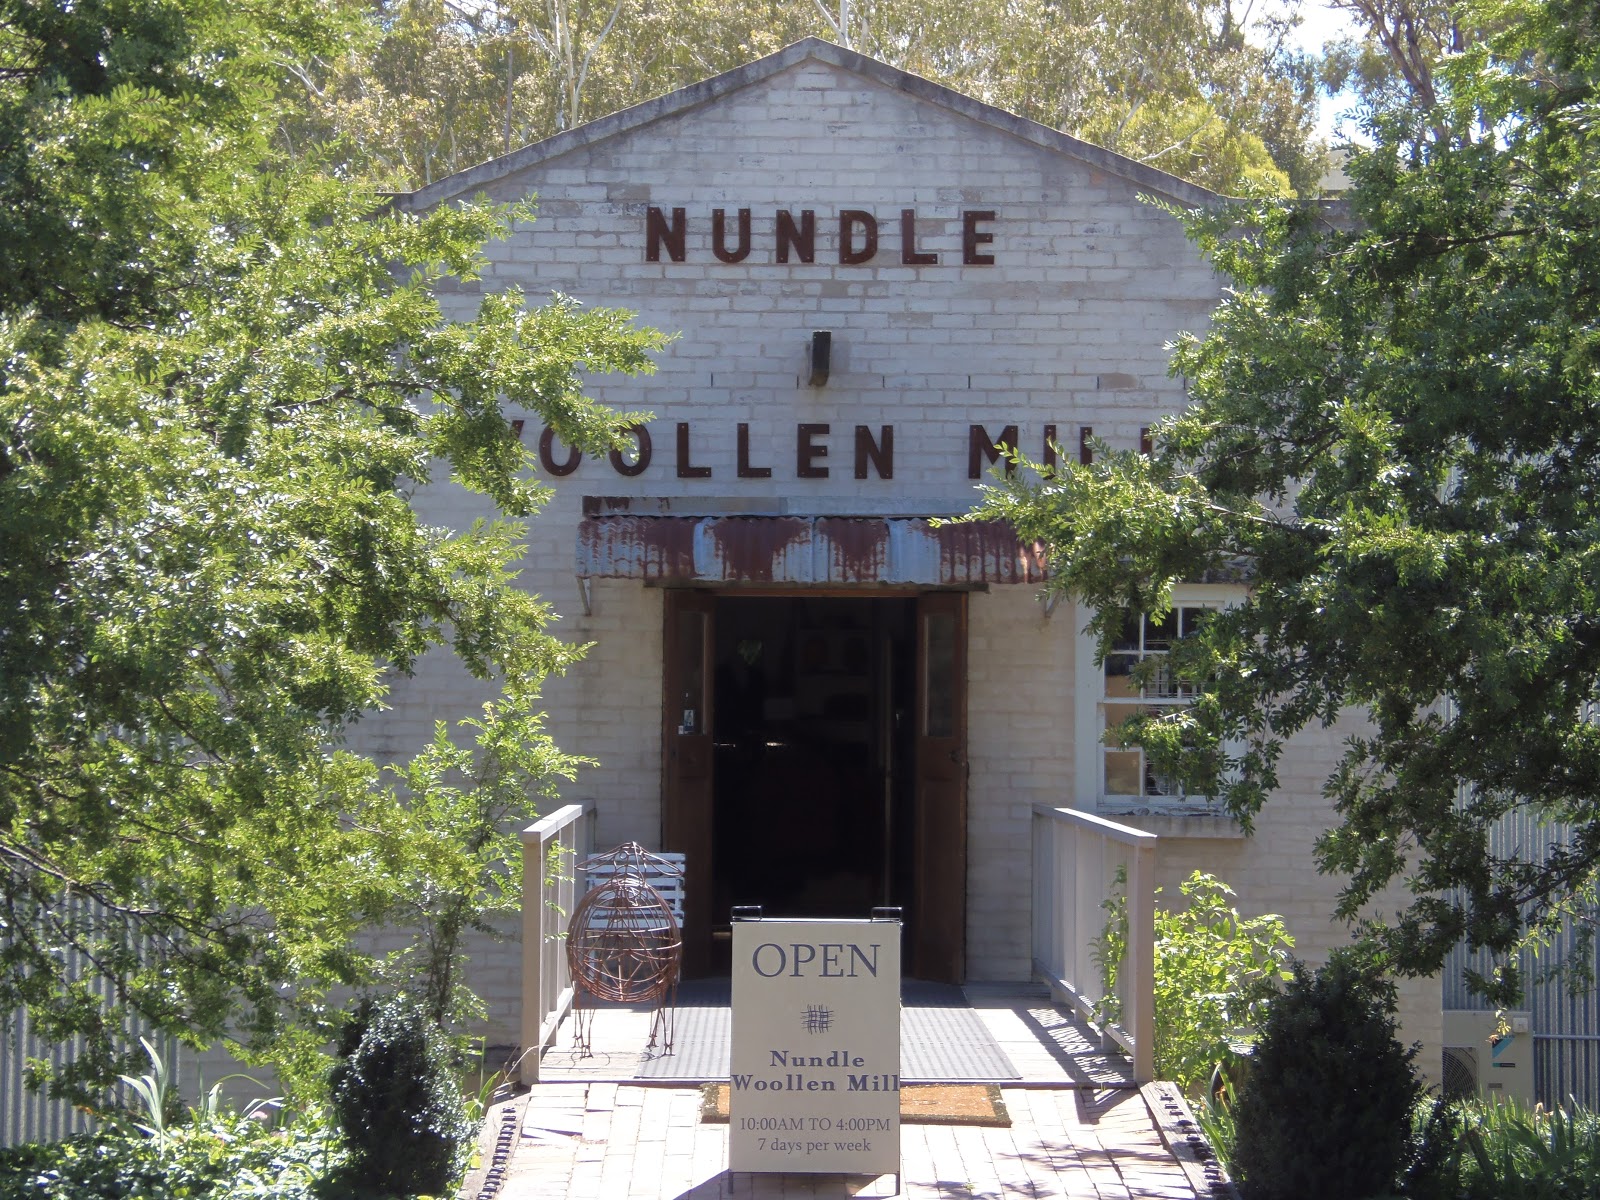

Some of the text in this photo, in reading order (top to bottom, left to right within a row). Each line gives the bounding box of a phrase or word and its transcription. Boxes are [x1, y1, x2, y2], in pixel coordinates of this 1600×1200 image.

[645, 206, 995, 266] NUNDLE
[509, 419, 894, 480] OOLLEN
[752, 943, 881, 978] OPEN
[769, 1050, 865, 1068] Nundle
[731, 1074, 900, 1092] Woollen Mill
[740, 1117, 890, 1132] 10:00AM TO 4:00PM
[757, 1137, 872, 1154] 7 days per week
